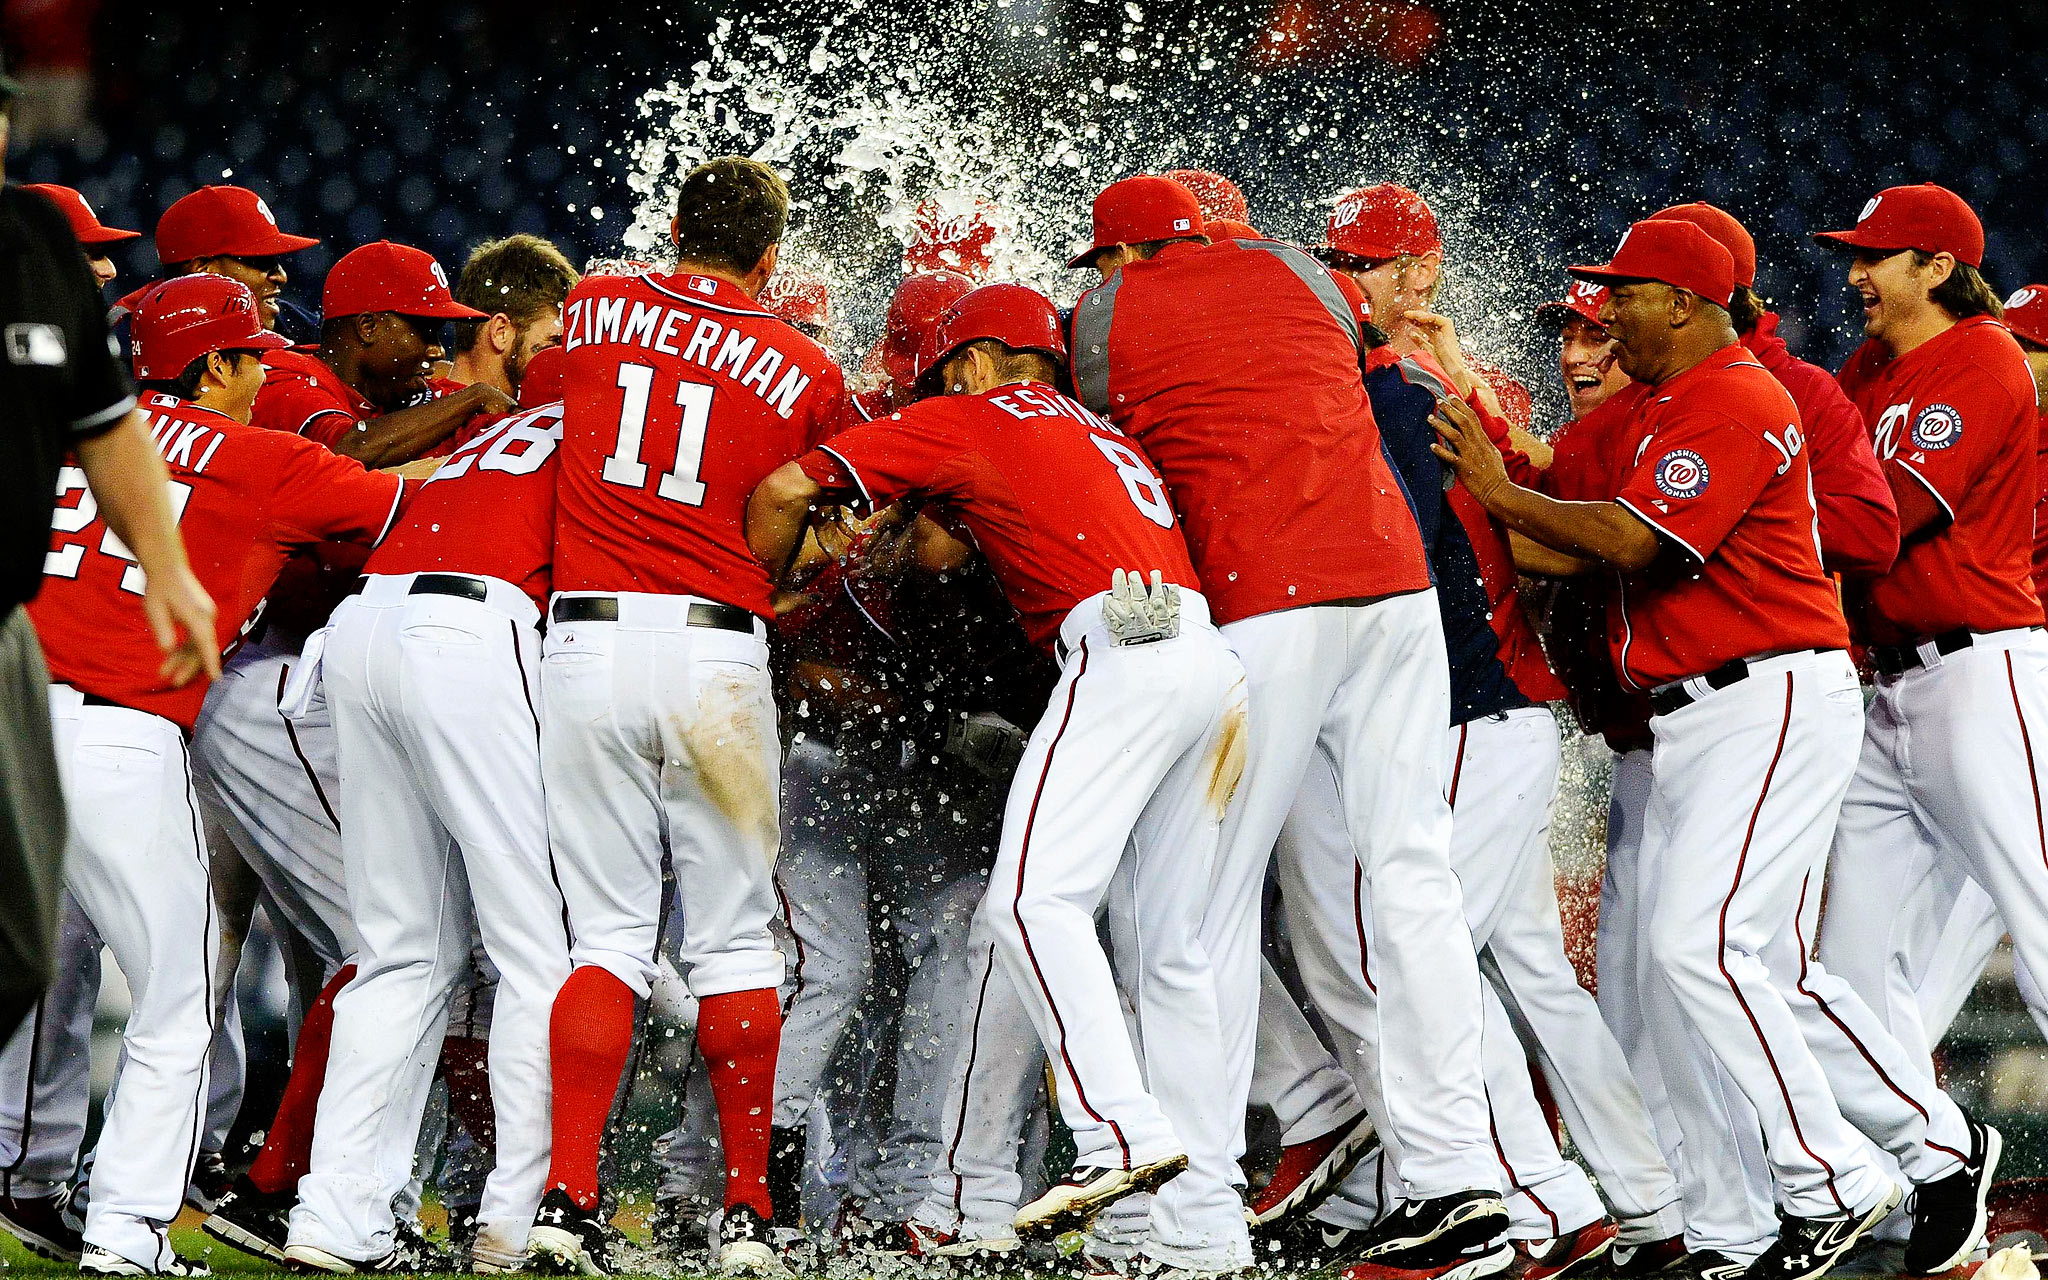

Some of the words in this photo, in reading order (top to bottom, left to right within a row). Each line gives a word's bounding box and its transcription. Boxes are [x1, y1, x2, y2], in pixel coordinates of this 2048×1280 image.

[566, 297, 811, 420] ZIMMERMAN
[134, 408, 226, 474] UKI
[419, 400, 564, 492] 28
[602, 361, 715, 507] 11
[1911, 430, 1951, 450] NATIONALS
[1919, 403, 1962, 433] WASHINGTON
[1089, 431, 1175, 530] 8
[1655, 473, 1697, 498] NATIONALS
[1663, 449, 1709, 483] WASHINGTON
